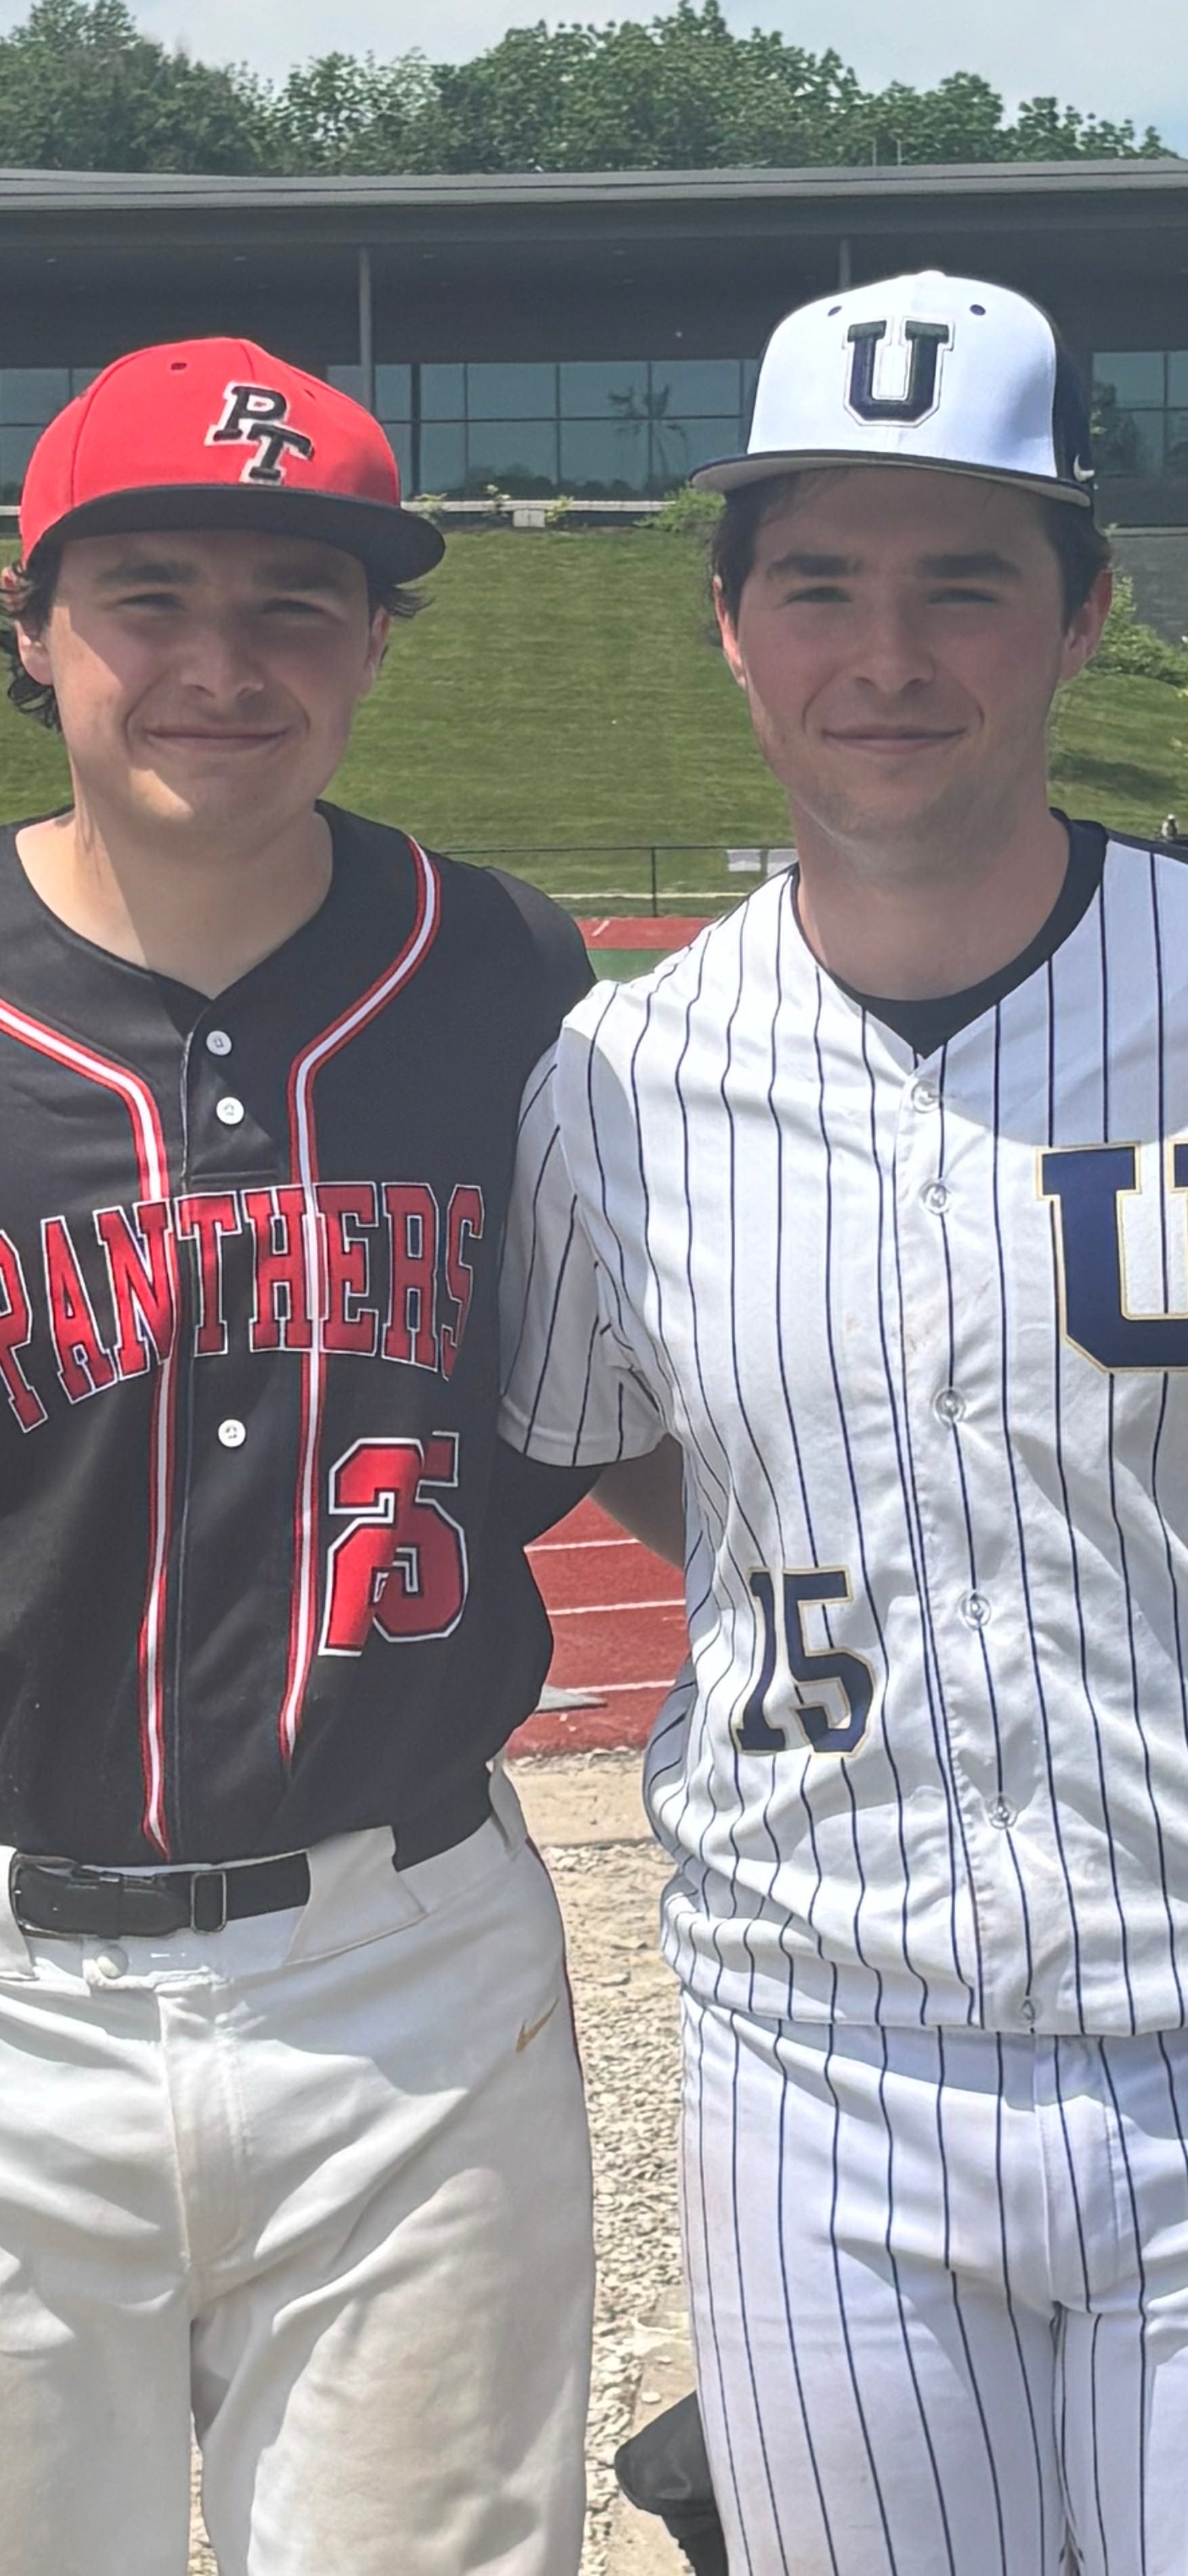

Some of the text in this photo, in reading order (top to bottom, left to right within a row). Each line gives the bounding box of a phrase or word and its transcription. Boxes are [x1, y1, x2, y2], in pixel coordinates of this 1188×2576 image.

[204, 381, 314, 485] PT
[842, 316, 955, 428] U
[0, 1181, 484, 1433] PANTHERS
[1036, 1140, 1188, 1373] U
[318, 1431, 469, 1657] 25
[730, 1566, 877, 1758] 15
